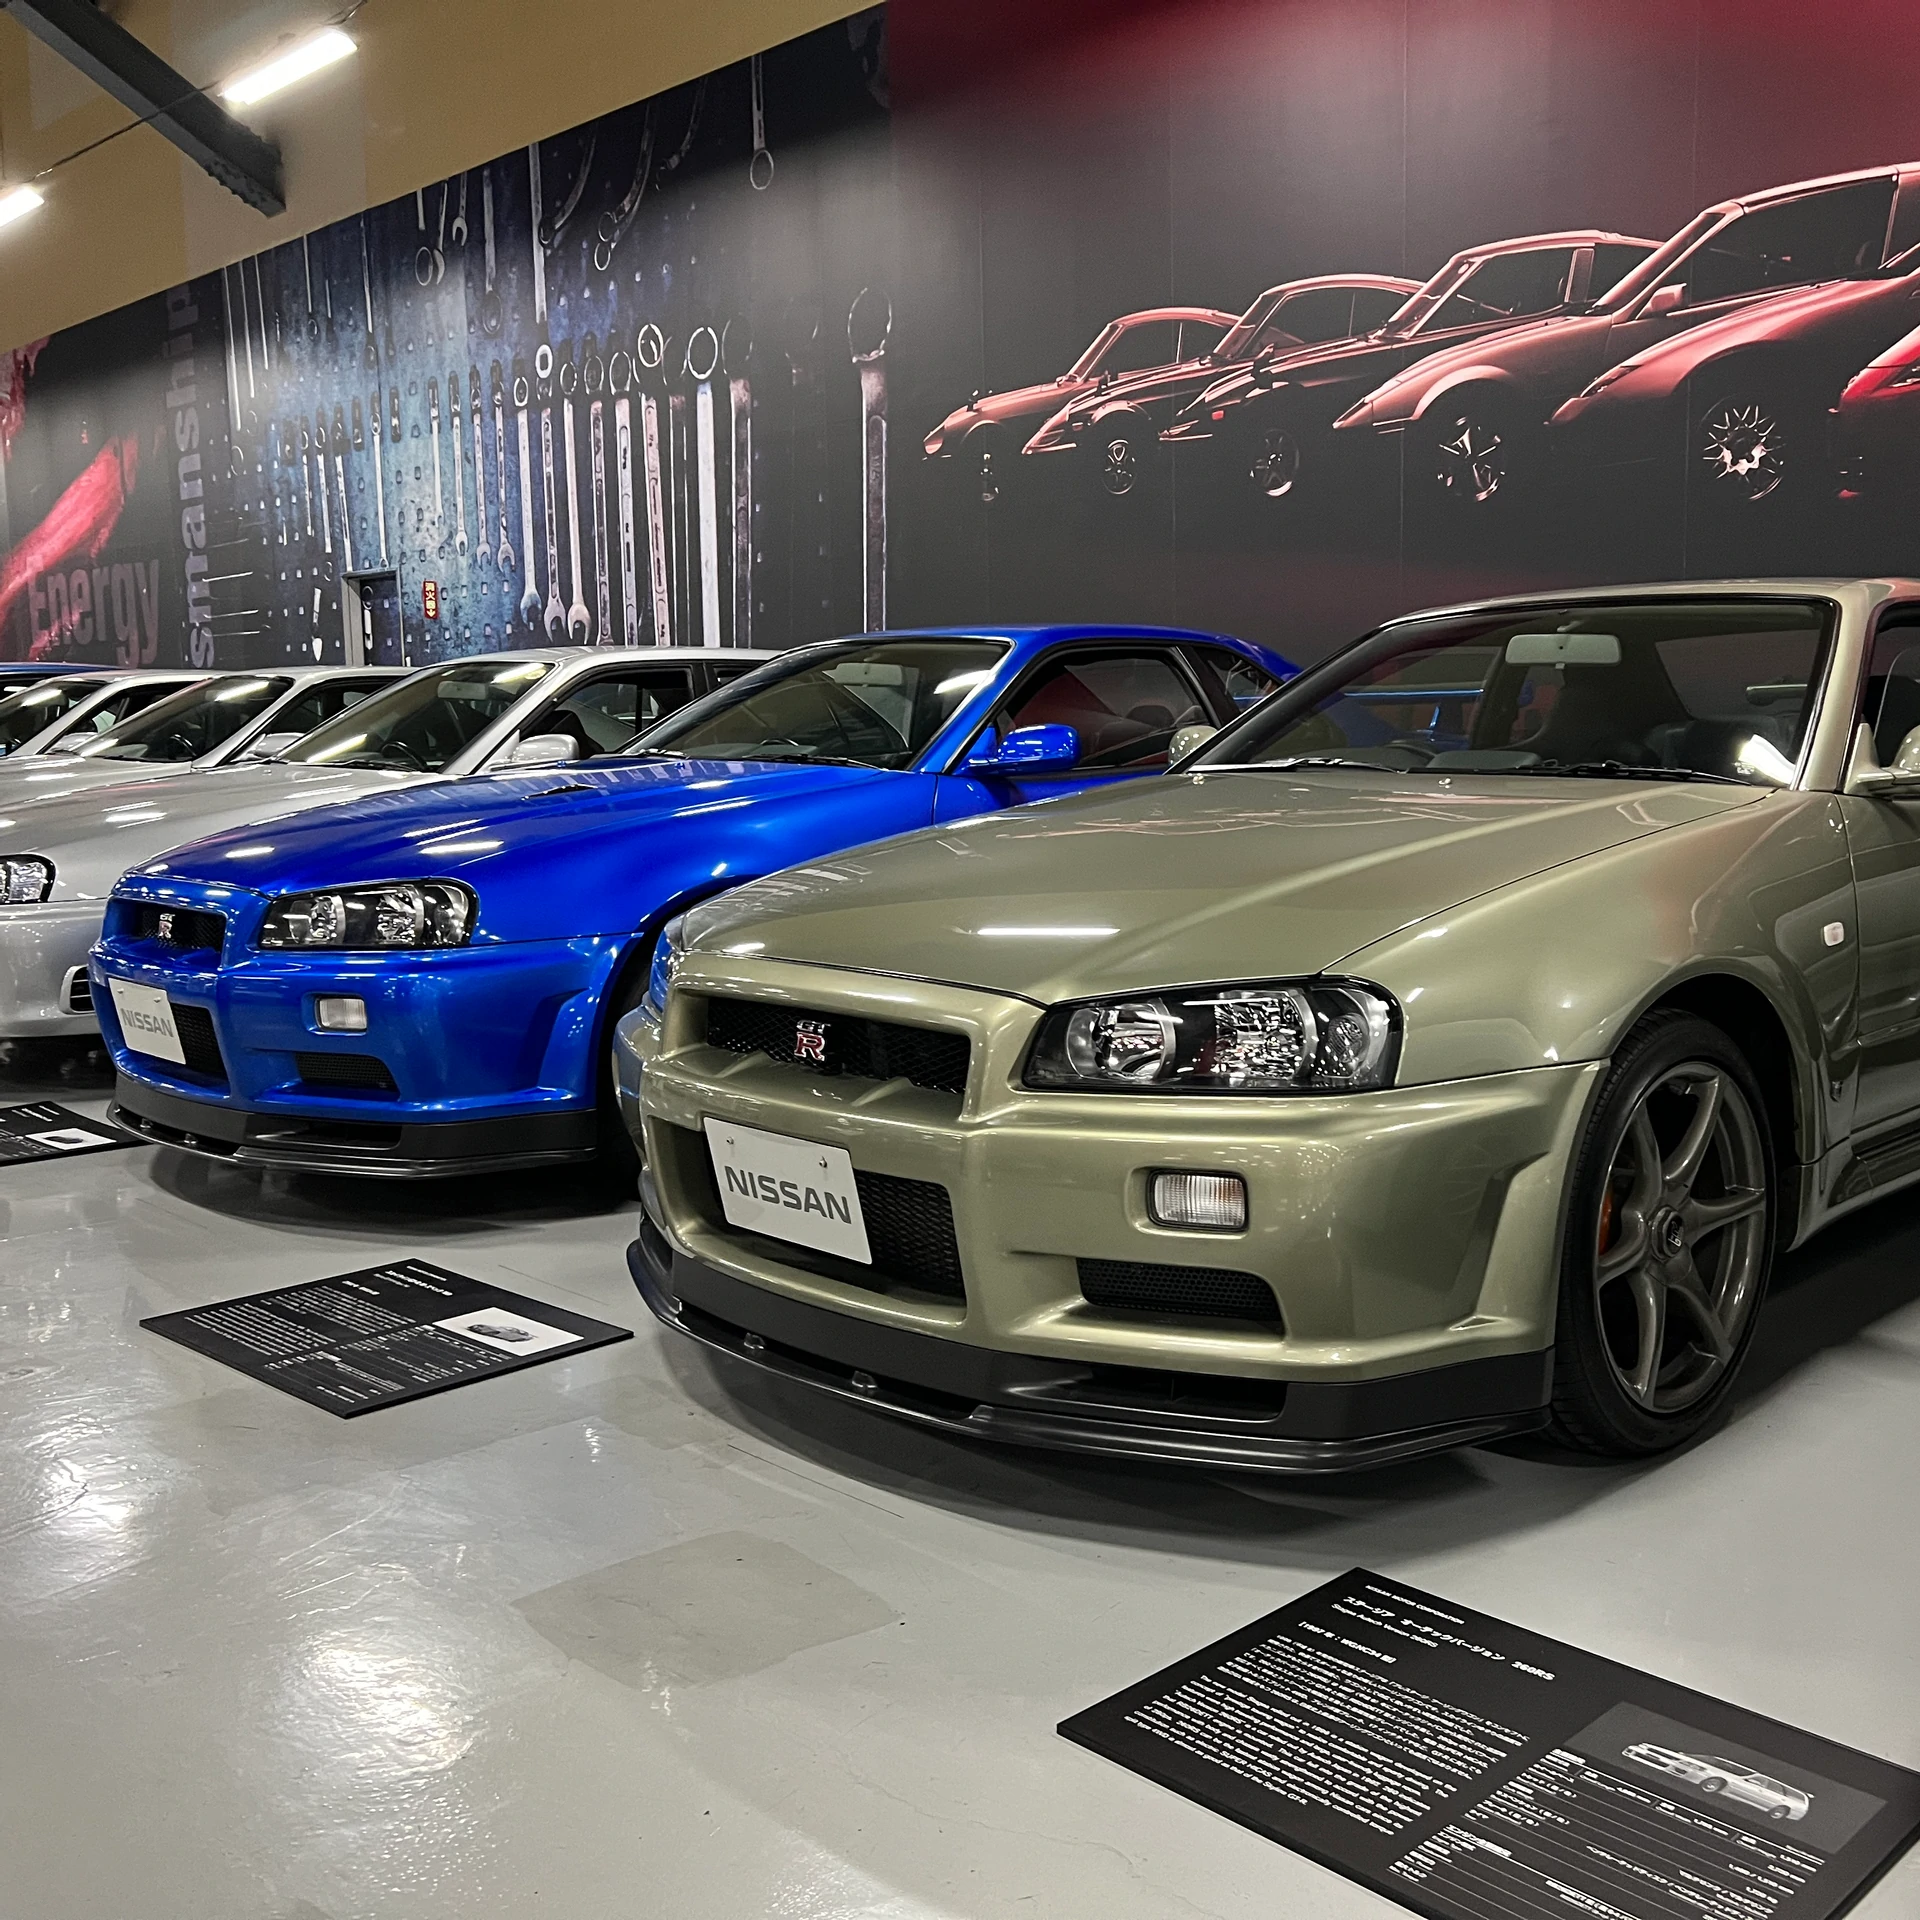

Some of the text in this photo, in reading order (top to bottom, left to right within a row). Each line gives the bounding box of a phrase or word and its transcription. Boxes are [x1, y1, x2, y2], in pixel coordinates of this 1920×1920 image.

[26, 554, 160, 669] Energy
[120, 1008, 174, 1038] NISSAN
[794, 1032, 826, 1062] R
[724, 1165, 852, 1224] NISSAN
[1343, 1596, 1396, 1617] ステージア
[1511, 1661, 1556, 1681] 260RS
